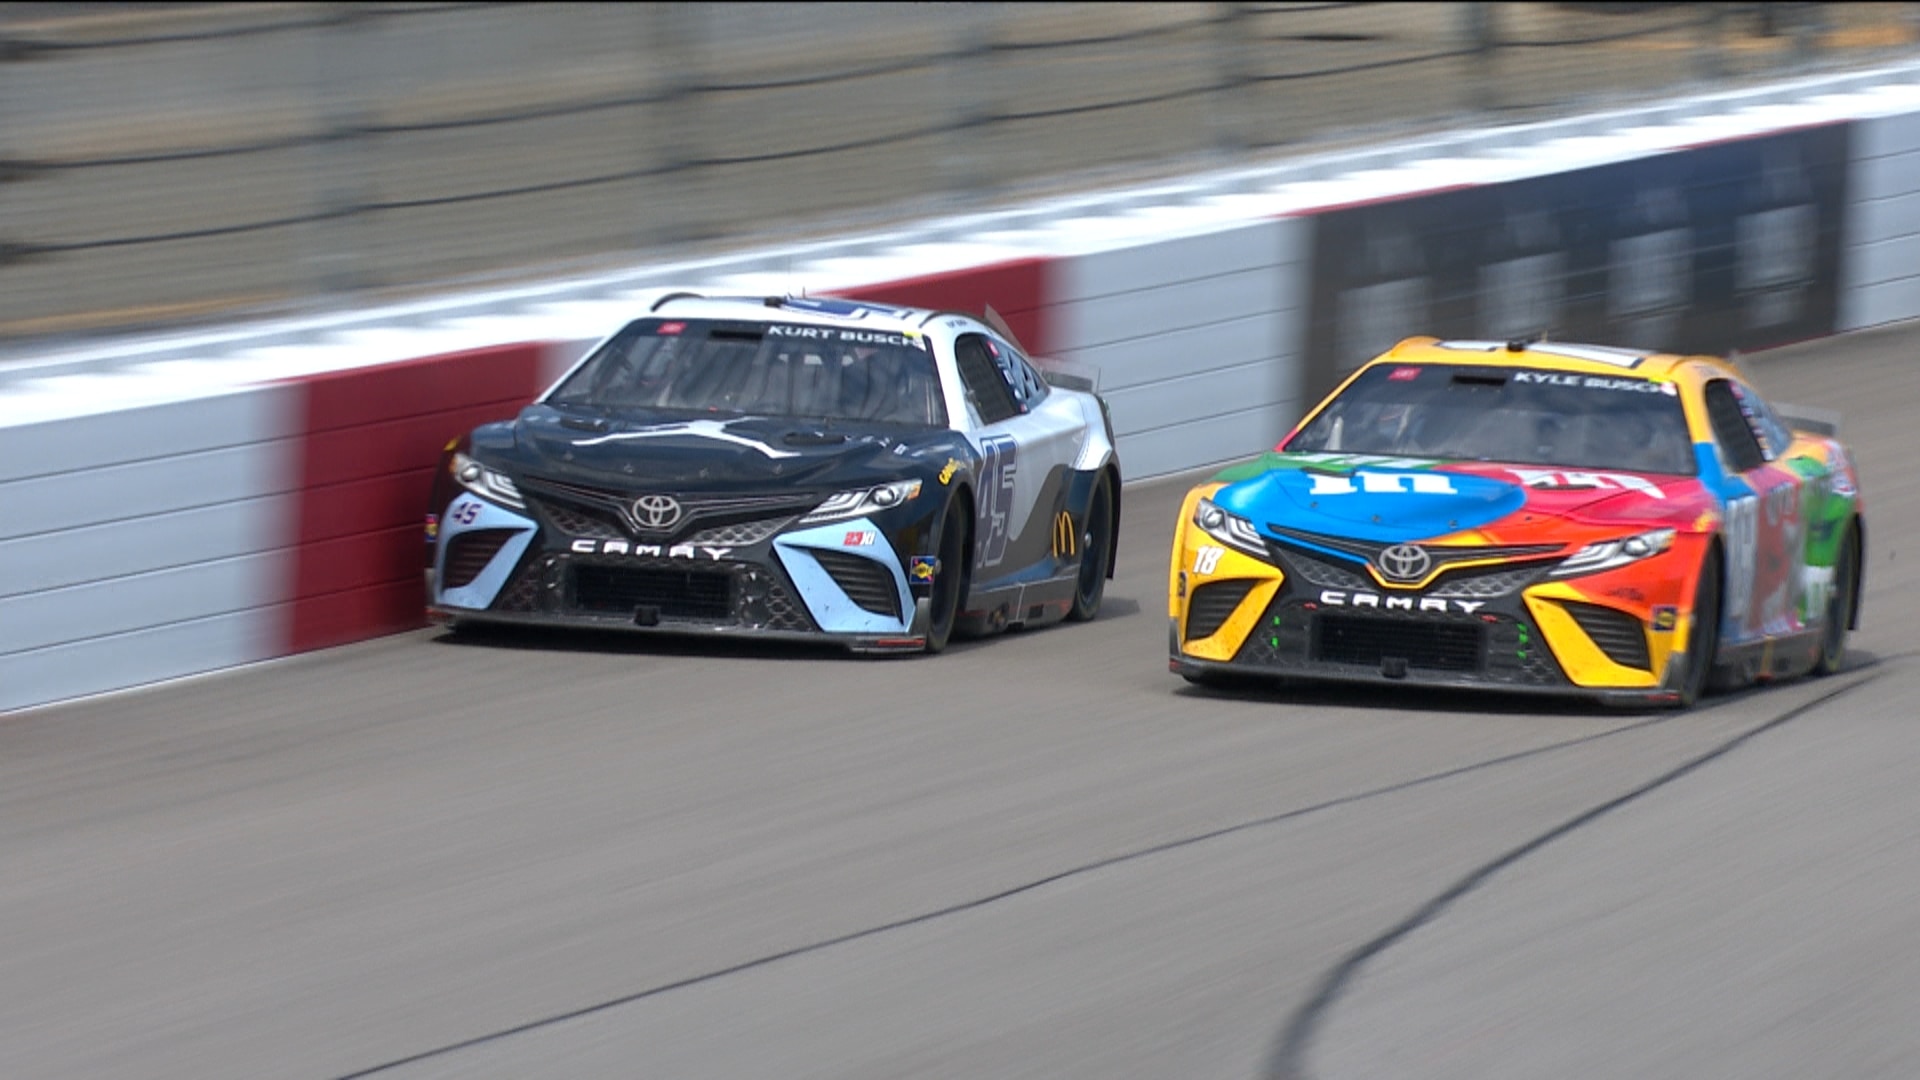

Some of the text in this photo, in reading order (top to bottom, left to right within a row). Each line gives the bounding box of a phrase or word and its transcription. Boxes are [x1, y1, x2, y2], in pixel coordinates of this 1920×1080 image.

[768, 324, 921, 347] KURT BUSCH
[1513, 371, 1581, 386] KYLE
[978, 434, 1018, 568] 45
[453, 501, 483, 525] 45
[571, 538, 733, 561] CAMRY
[1192, 545, 1226, 576] 18
[1320, 590, 1487, 613] CAMRY
